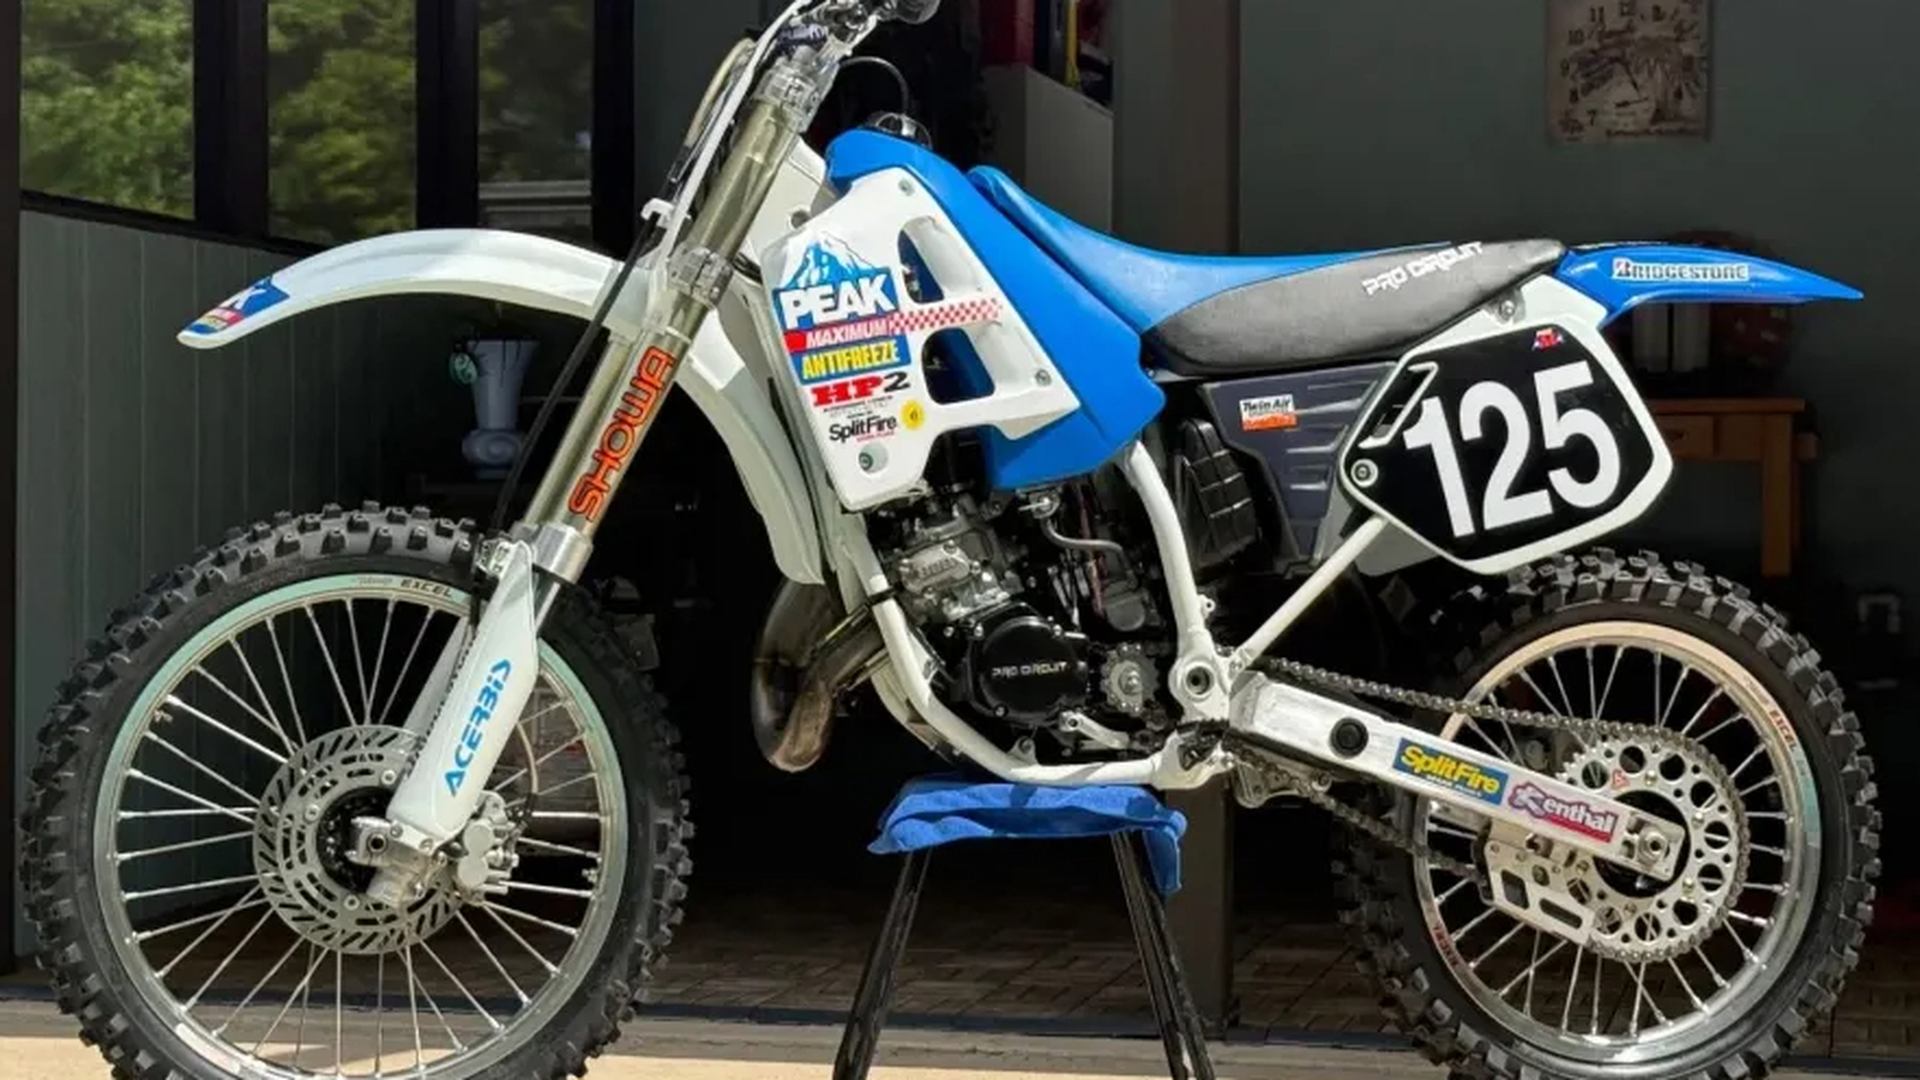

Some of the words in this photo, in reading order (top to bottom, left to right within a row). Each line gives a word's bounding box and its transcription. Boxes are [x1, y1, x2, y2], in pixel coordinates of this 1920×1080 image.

[1361, 266, 1408, 296] PRO
[1406, 241, 1483, 278] CIRCUIT
[1615, 258, 1746, 280] BRIDGESTONE
[779, 273, 897, 330] PEAK
[806, 319, 887, 349] MAXIMUM
[802, 341, 900, 380] ANTIFREEZE
[811, 371, 911, 407] HP2
[568, 345, 677, 522] SHOWA
[829, 414, 898, 444] SplitFire
[1402, 360, 1621, 538] 125
[400, 579, 453, 598] EXCEL
[991, 665, 1018, 679] PRO
[1020, 661, 1067, 677] CIRCUIT
[1400, 745, 1500, 794] SplitFire
